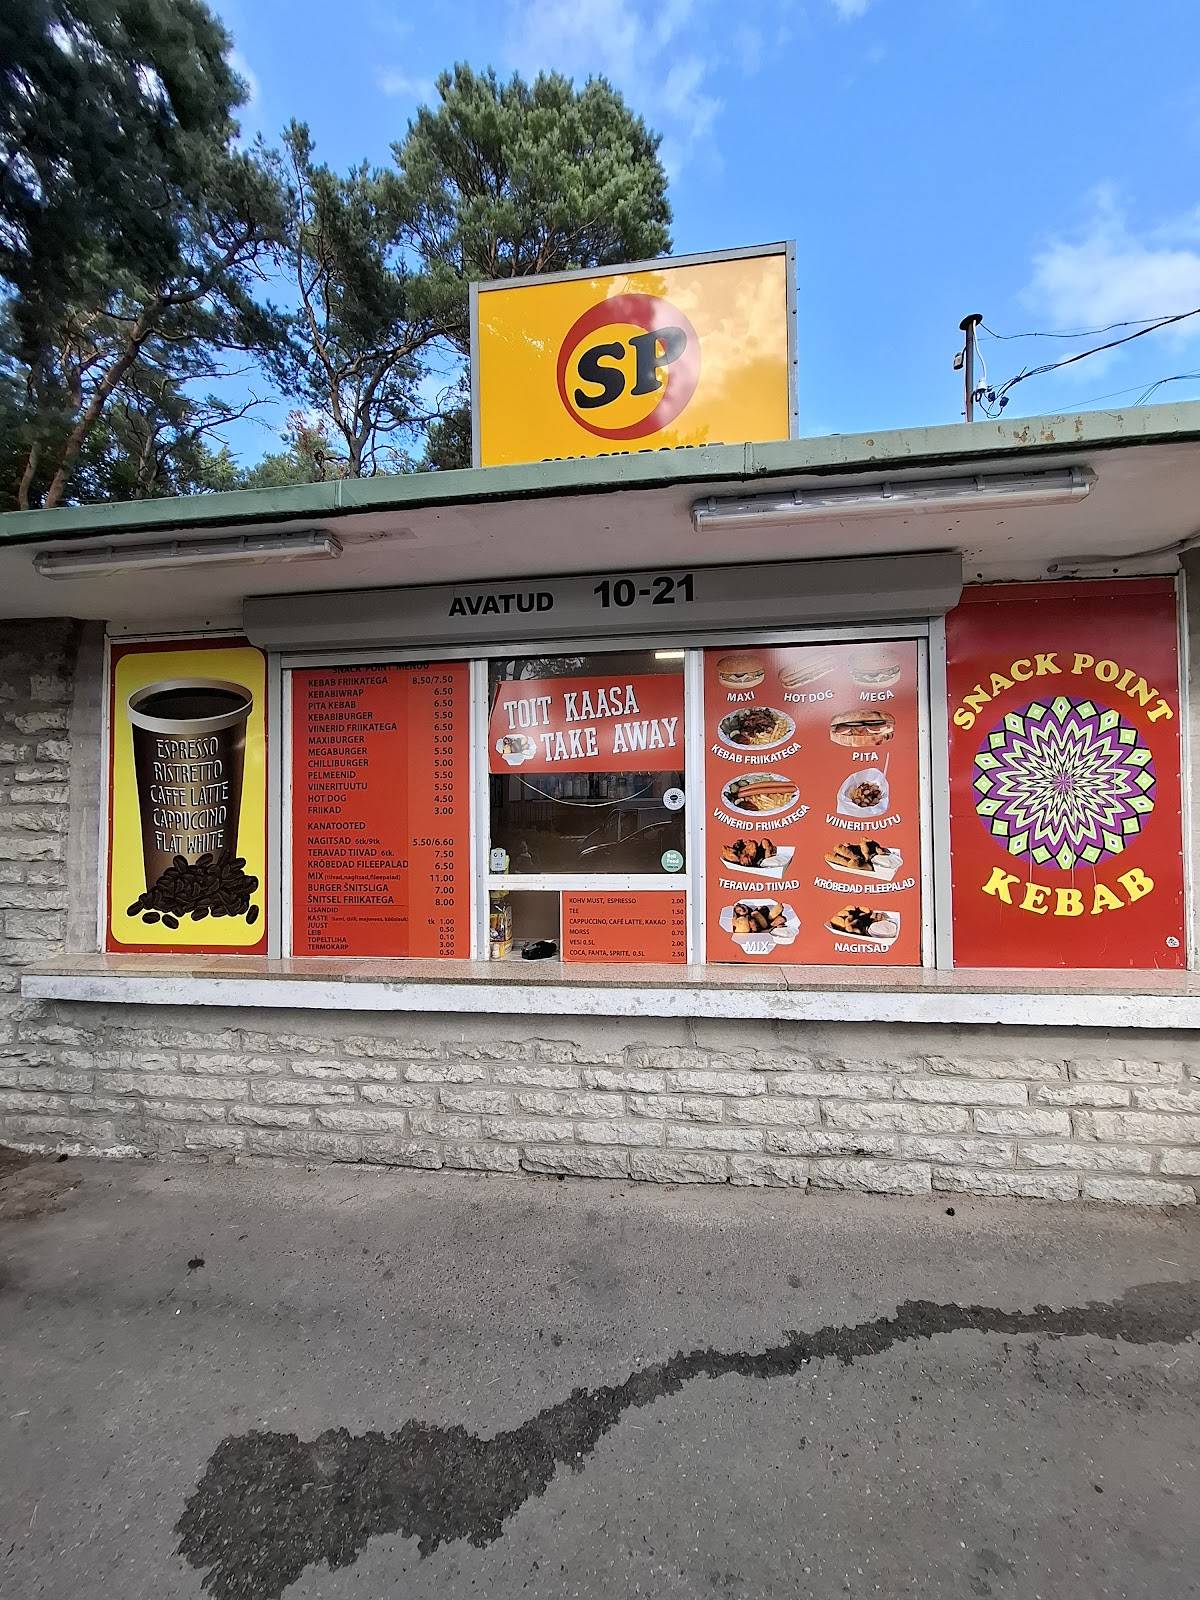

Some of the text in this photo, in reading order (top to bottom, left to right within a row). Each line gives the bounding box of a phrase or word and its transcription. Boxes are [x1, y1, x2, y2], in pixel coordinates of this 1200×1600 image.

[574, 326, 688, 409] SP
[448, 573, 695, 617] AVATUD 10-21
[308, 678, 336, 687] KEBAB
[338, 676, 388, 686] FRIIKATEGA
[308, 688, 453, 699] KEBABIWRAP 6.50
[727, 690, 755, 702] MAXI
[784, 689, 834, 704] HOT DOG
[859, 689, 895, 702] MEGA
[953, 652, 1174, 731] SNACK POINT
[308, 700, 453, 711] PITA KEBAB 6.50
[503, 684, 640, 730] TOIT KAASA
[308, 711, 453, 722] KEBABIBURGER 5.50
[308, 722, 453, 733] VIINERID FRIIKATEGA 6.50
[308, 735, 453, 745] MAXIBURGER 5.00
[540, 716, 679, 762] TAKE AWAY
[157, 736, 219, 759] ESPRESSO
[308, 747, 453, 756] MEGABURGER 5.50
[711, 742, 802, 765] KEBAB FRIIKATEGA
[852, 751, 879, 762] PITA
[308, 758, 453, 768] CHILLIBURGER 5.00
[153, 759, 223, 783] RISTRETTO
[308, 771, 453, 779] PELMEENID 5.50
[308, 783, 453, 791] VIINERITUUTU 5.50
[190, 781, 229, 806] LATTE
[308, 794, 453, 803] HOT DOG 4.50
[308, 806, 453, 815] FRIIKAD 3.00
[153, 805, 227, 831] CAPPUCCINO
[713, 804, 811, 831] VIINERID FRIIKATEGA
[825, 813, 901, 831] VIINERITUUTU
[308, 822, 366, 830] KANATOOTED
[155, 829, 225, 854] FLAT WHITE
[308, 837, 351, 845] NAGITSAD
[412, 838, 454, 847] 5.50/6.60
[308, 849, 347, 857] TERAVAD
[349, 849, 377, 857] TIIVAD
[434, 850, 454, 858] 7.50
[357, 860, 409, 868] FILEEPALAD
[434, 862, 454, 870] 6.50
[308, 872, 323, 880] MIX
[308, 884, 341, 892] BURGER
[343, 882, 389, 892] ŠNITSLIGA
[718, 878, 800, 891] TERAVAD TIIVAD
[864, 877, 915, 894] FILEEPALAD
[982, 866, 1155, 917] KEBAB
[308, 894, 341, 904] ŠNITSEL
[343, 895, 394, 904] FRIIKATEGA
[745, 941, 770, 951] MIX
[834, 942, 889, 953] NAGITSAD
